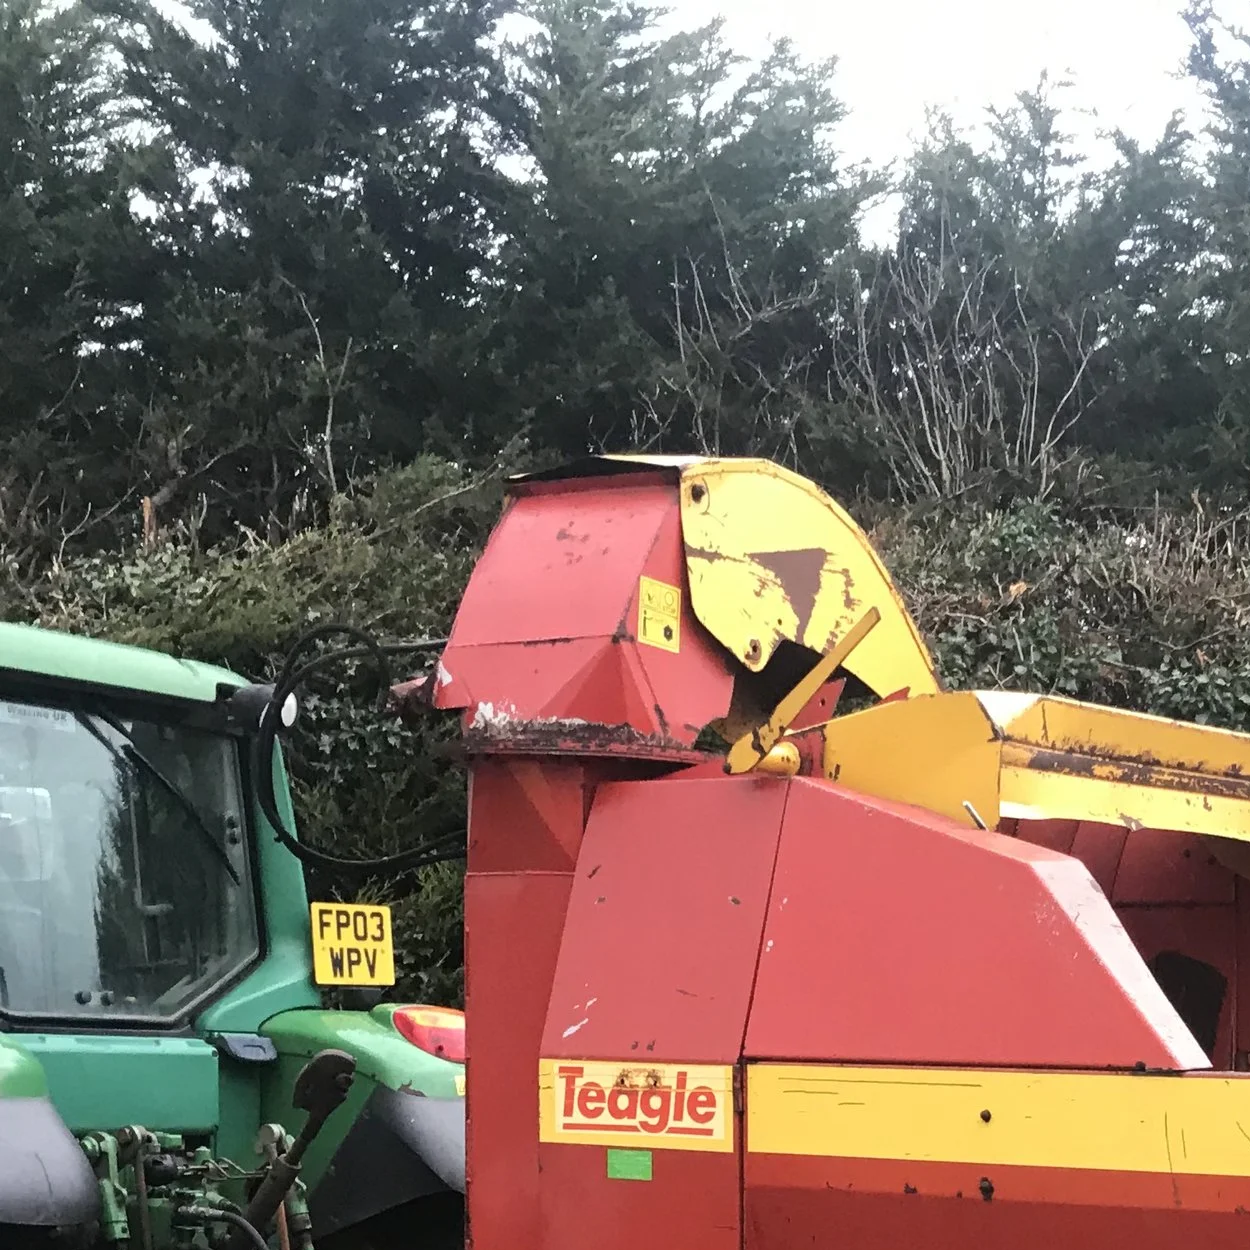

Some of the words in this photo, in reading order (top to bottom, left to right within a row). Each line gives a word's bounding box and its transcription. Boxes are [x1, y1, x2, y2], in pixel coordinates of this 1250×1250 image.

[318, 908, 385, 942] FP03
[329, 946, 378, 979] WPV
[558, 1065, 717, 1134] Teagle
